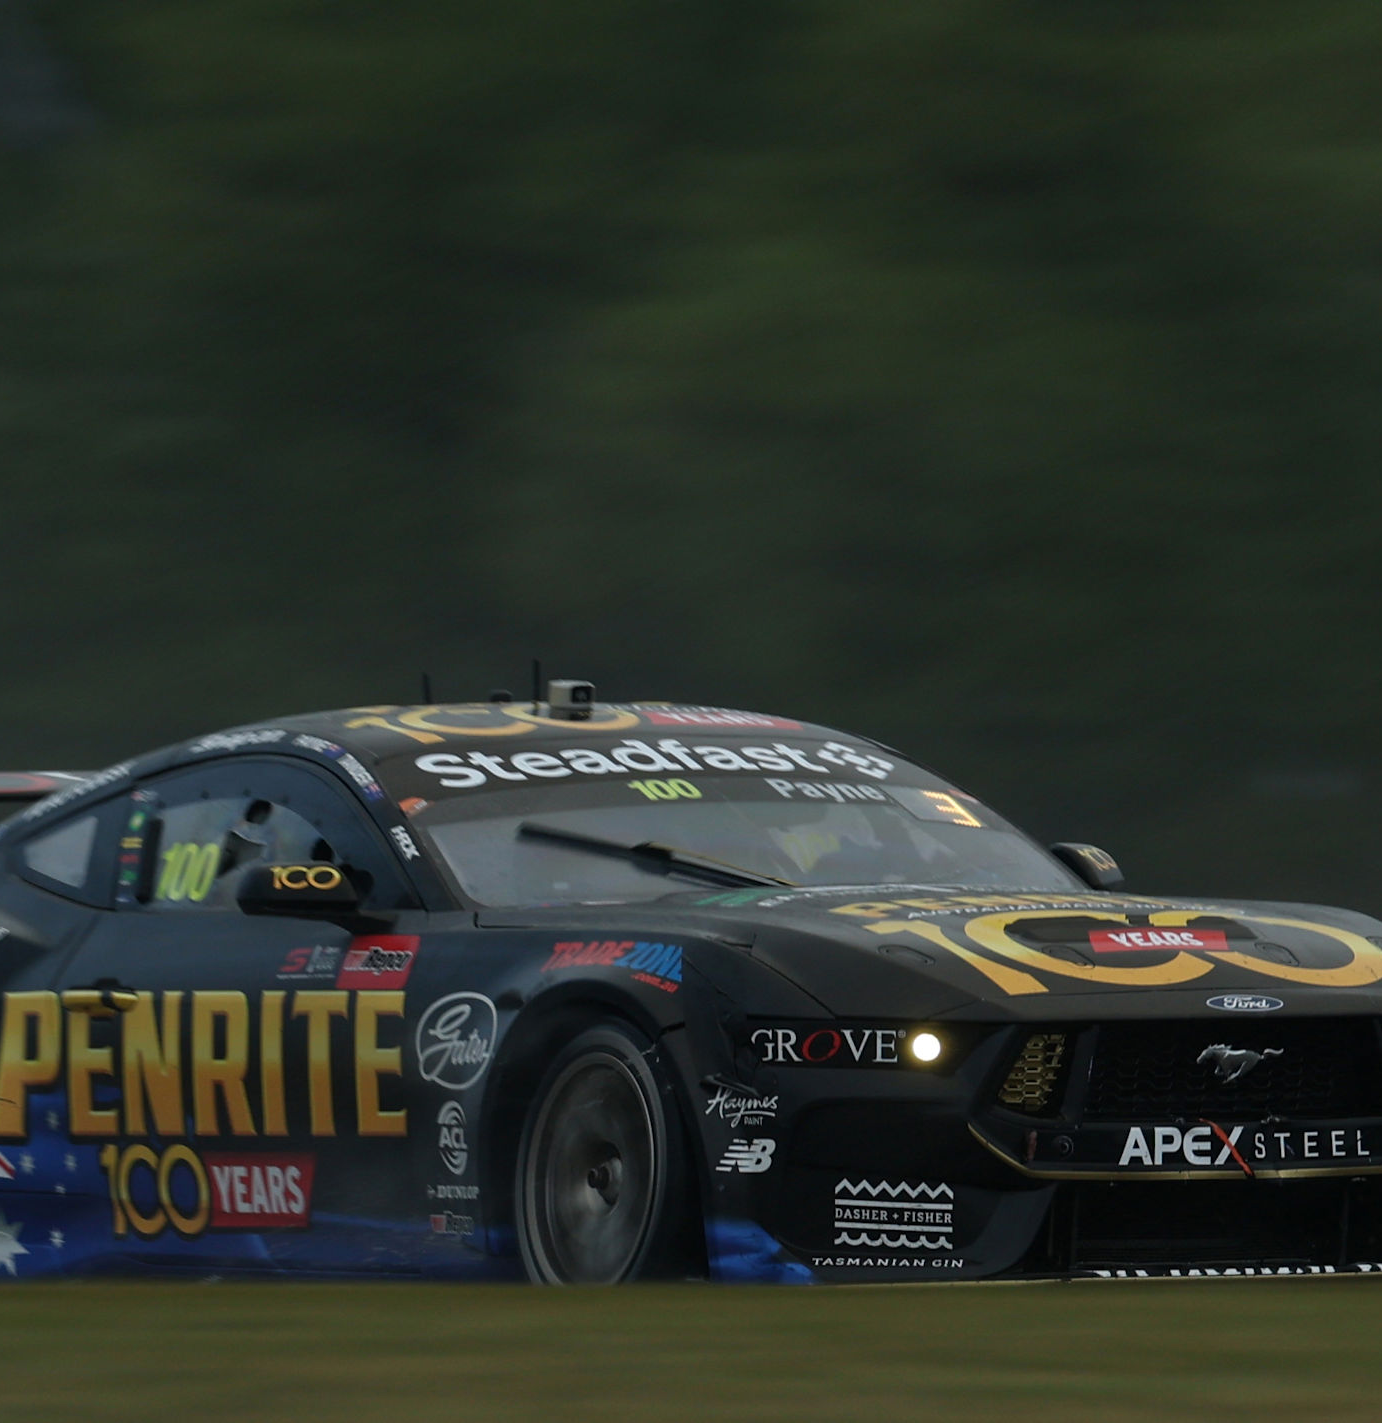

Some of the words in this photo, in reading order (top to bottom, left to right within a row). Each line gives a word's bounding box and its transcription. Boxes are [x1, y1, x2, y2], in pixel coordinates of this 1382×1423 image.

[415, 739, 829, 789] Steadfast
[628, 779, 704, 801] 100
[763, 778, 888, 804] Payne
[155, 842, 220, 903] 100
[269, 865, 342, 890] 100
[1106, 929, 1206, 949] YEARS
[1222, 996, 1270, 1009] Ford
[705, 1086, 779, 1128] Haymes
[743, 1115, 764, 1126] PAINT
[438, 1126, 468, 1150] ACL
[1118, 1125, 1245, 1167] APEX
[1253, 1129, 1371, 1160] STEEL
[100, 1143, 211, 1235] 100
[210, 1164, 307, 1216] YEARS
[436, 1184, 480, 1200] DUNLOP
[834, 1207, 889, 1222] DASHER
[903, 1210, 953, 1225] FISHER
[811, 1256, 926, 1268] TASMANIAN
[931, 1258, 965, 1269] GIN
